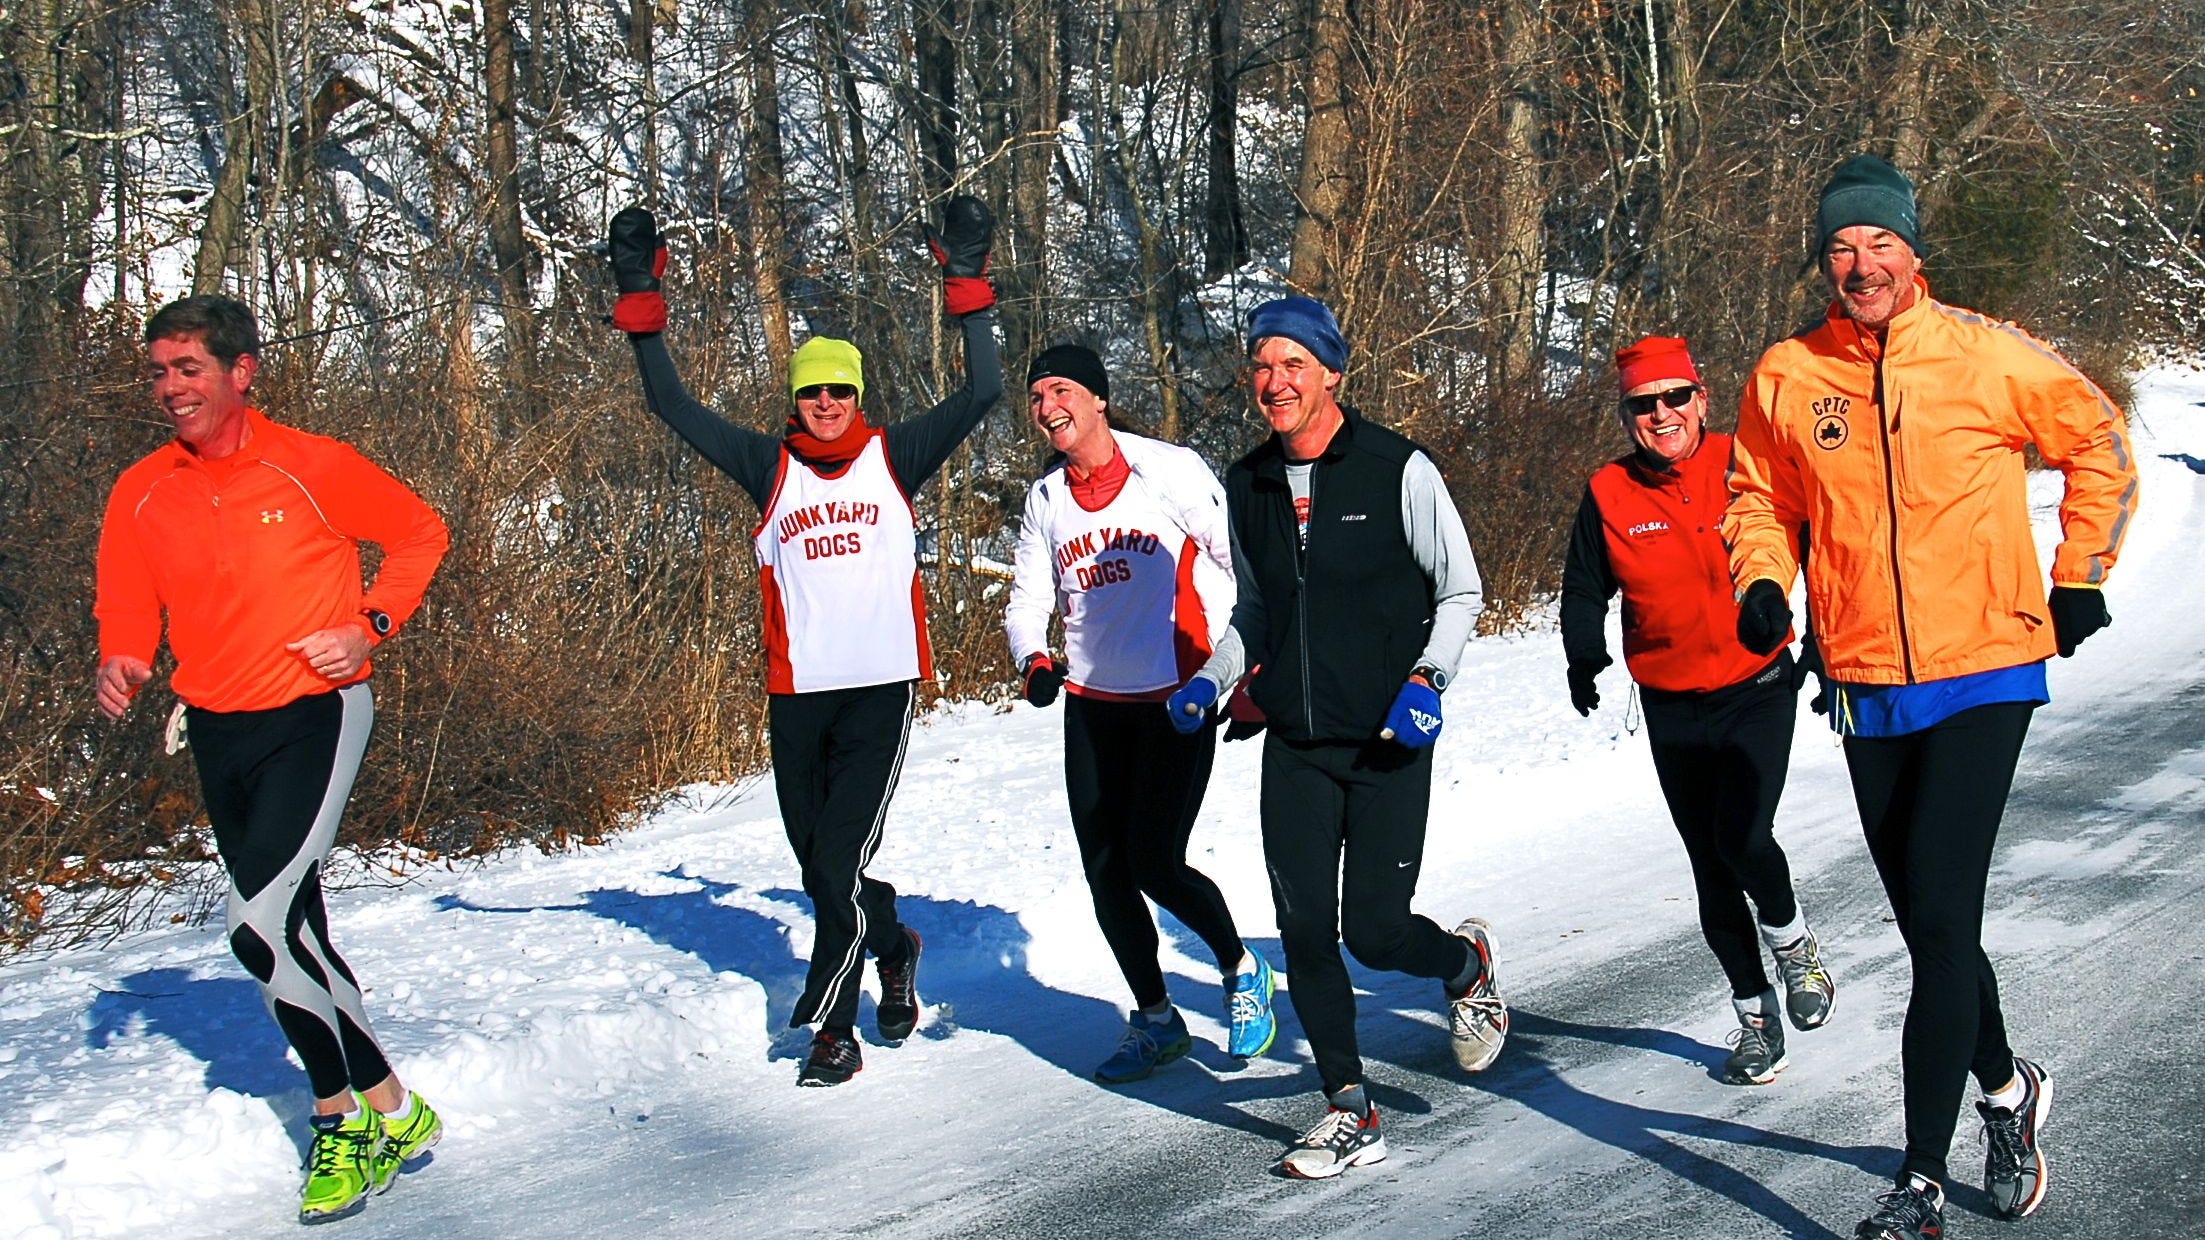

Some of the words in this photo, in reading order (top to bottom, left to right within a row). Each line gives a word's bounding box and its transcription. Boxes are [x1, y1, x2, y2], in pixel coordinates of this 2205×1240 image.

[1811, 396, 1851, 416] CPTC
[1628, 521, 1669, 536] POLSKA
[804, 532, 861, 561] DOGS
[1076, 558, 1132, 591] DOGS
